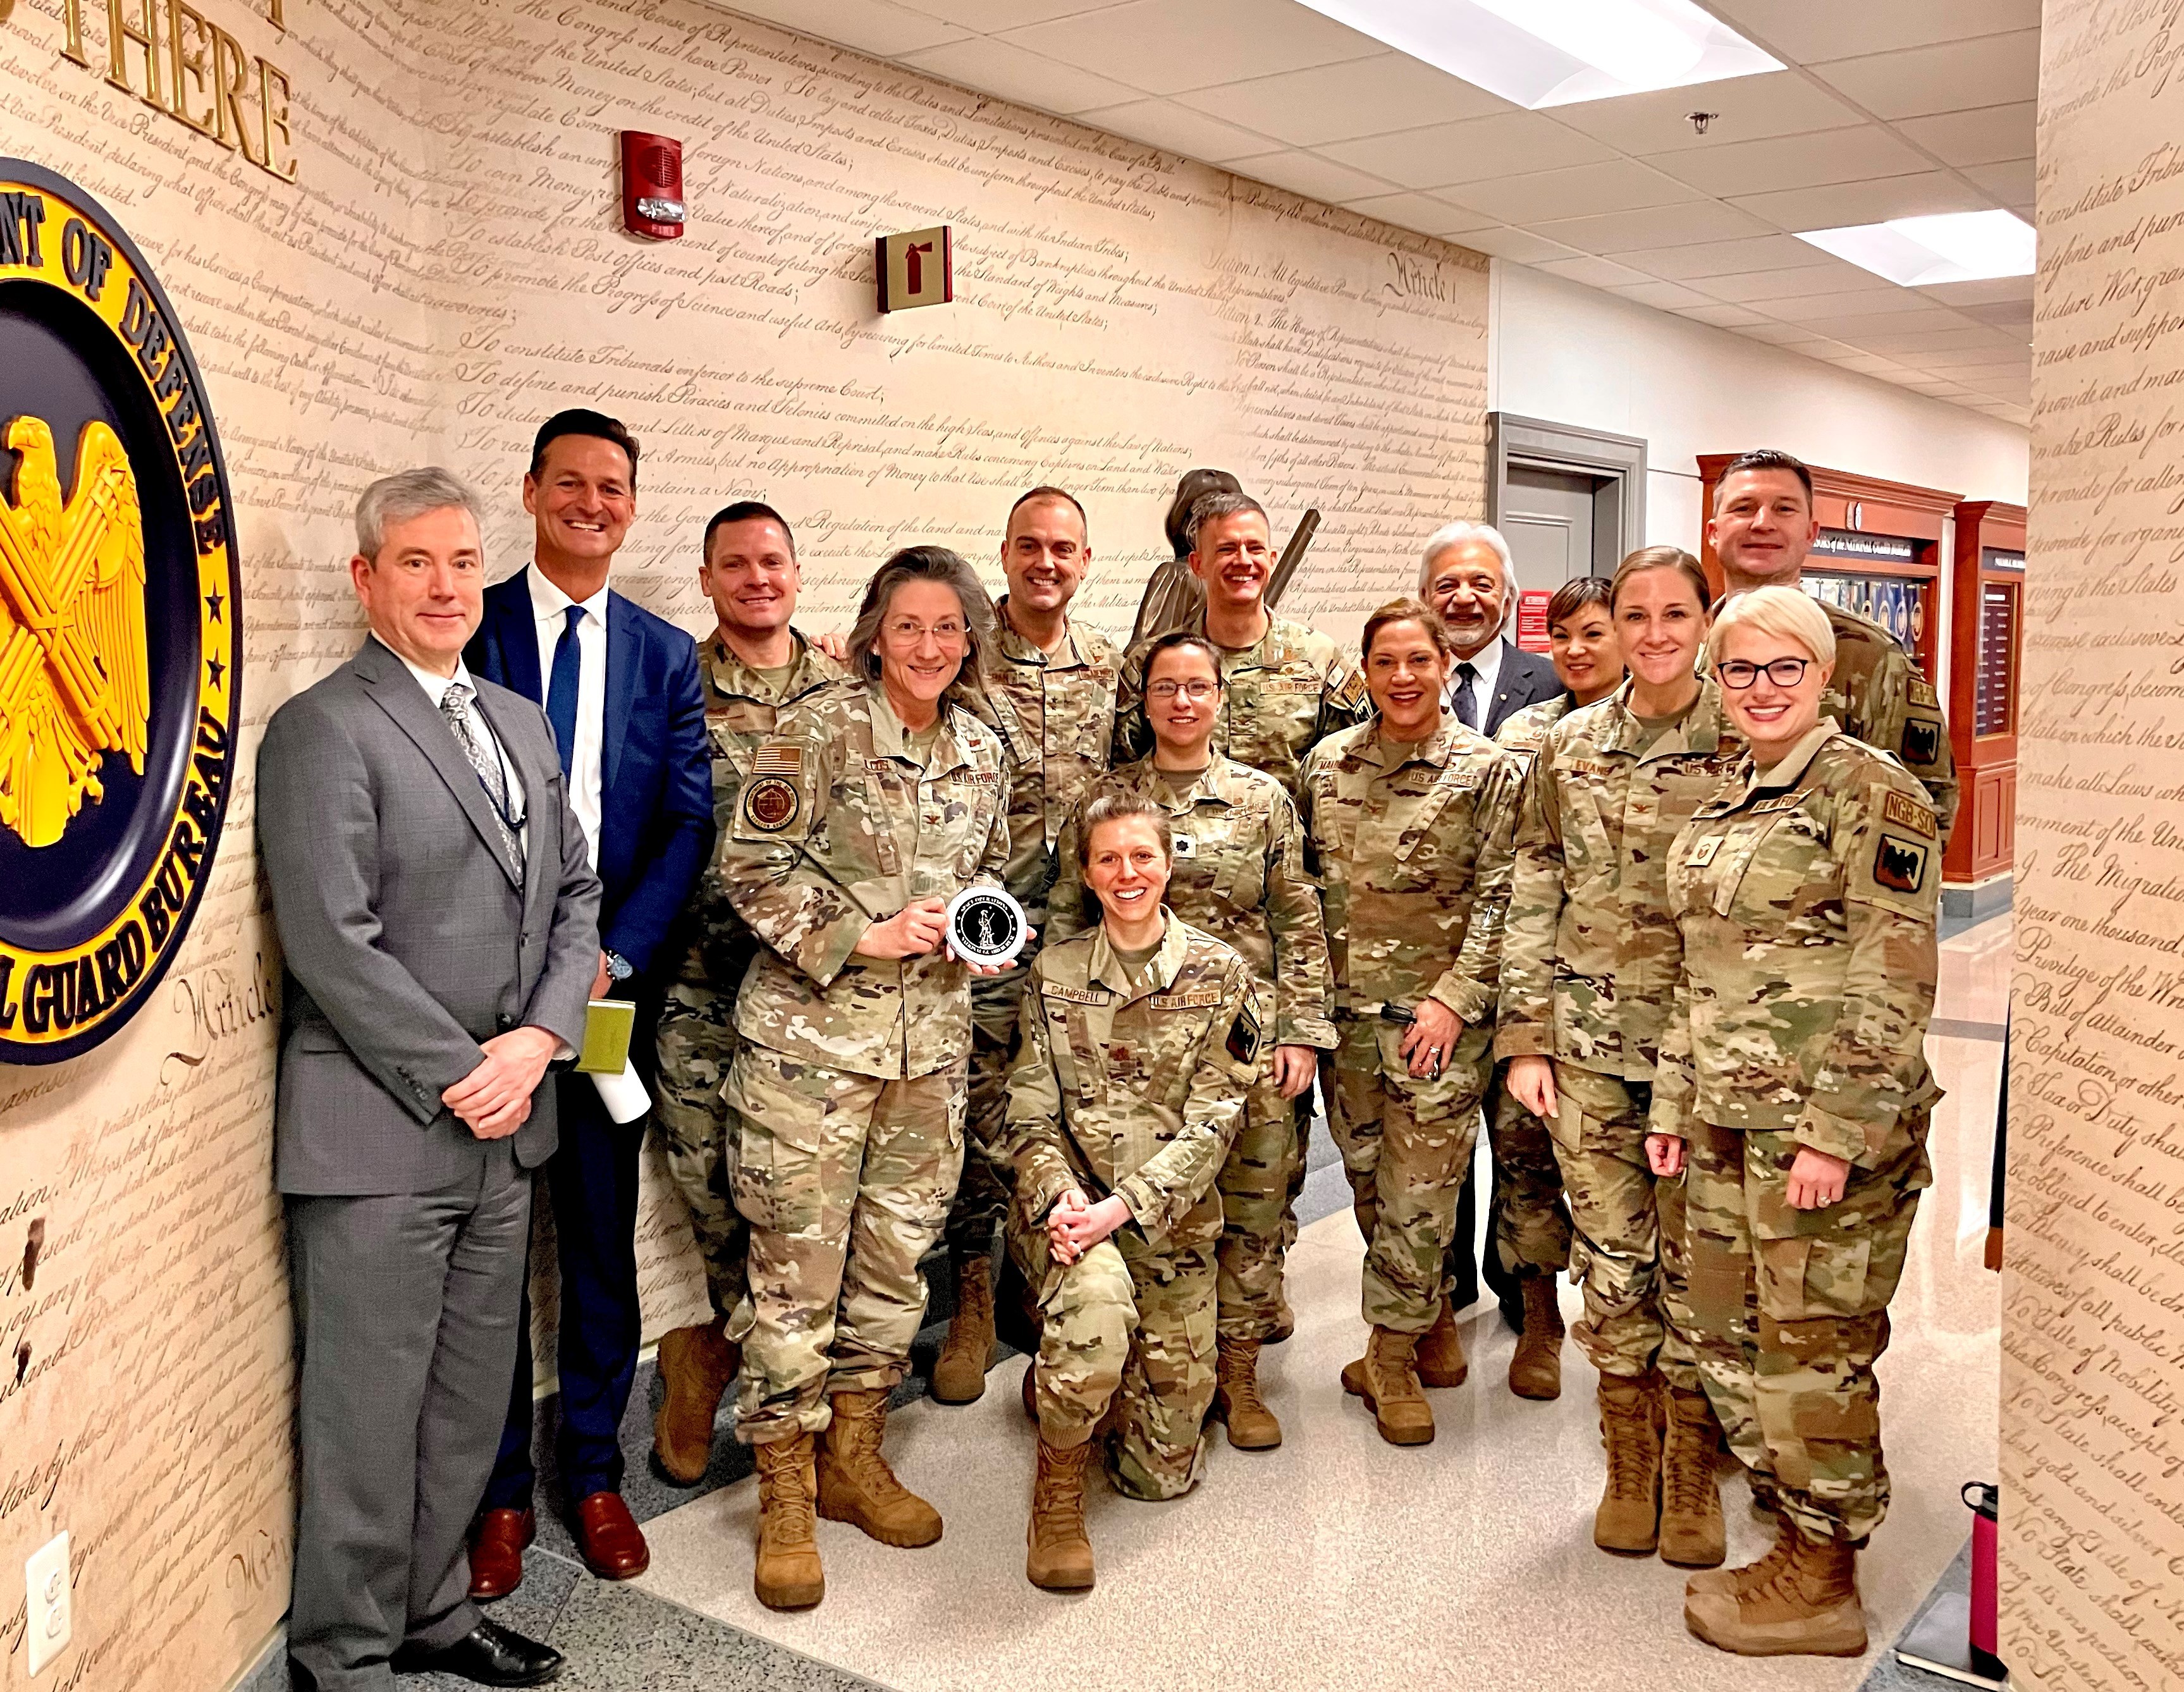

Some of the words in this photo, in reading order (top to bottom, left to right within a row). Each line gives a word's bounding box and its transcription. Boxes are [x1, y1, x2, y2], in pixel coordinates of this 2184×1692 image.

[684, 23, 711, 44] of
[639, 35, 678, 57] shall
[686, 47, 720, 71] have
[549, 68, 616, 116] Money
[754, 128, 804, 154] United
[582, 47, 646, 78] United
[697, 83, 725, 103] but
[856, 135, 885, 149] and
[485, 168, 522, 183] coin
[689, 141, 741, 175] foreign
[804, 179, 836, 192] and
[571, 238, 612, 265] Post
[2098, 217, 2144, 254] and
[561, 273, 589, 293] the
[2079, 322, 2124, 357] and
[505, 341, 586, 363] constitute
[589, 345, 674, 374] Tribunals
[61, 217, 113, 302] OF
[119, 278, 228, 556] DEFENSE
[500, 370, 558, 400] define
[561, 382, 604, 396] and
[595, 384, 668, 403] punish
[733, 399, 773, 414] and
[2100, 365, 2149, 402] and
[1294, 682, 1319, 694] FORCE
[1444, 773, 1473, 787] FORCE
[23, 920, 147, 1034] GUARD
[140, 706, 228, 952] BUREAU
[2052, 842, 2091, 881] The
[2061, 916, 2089, 931] one
[1050, 985, 1100, 1003] CAMPBELL
[2117, 966, 2147, 996] the
[1171, 995, 1187, 1008] AIR
[1187, 993, 1218, 1007] FORCE
[2112, 1166, 2167, 1201] shall
